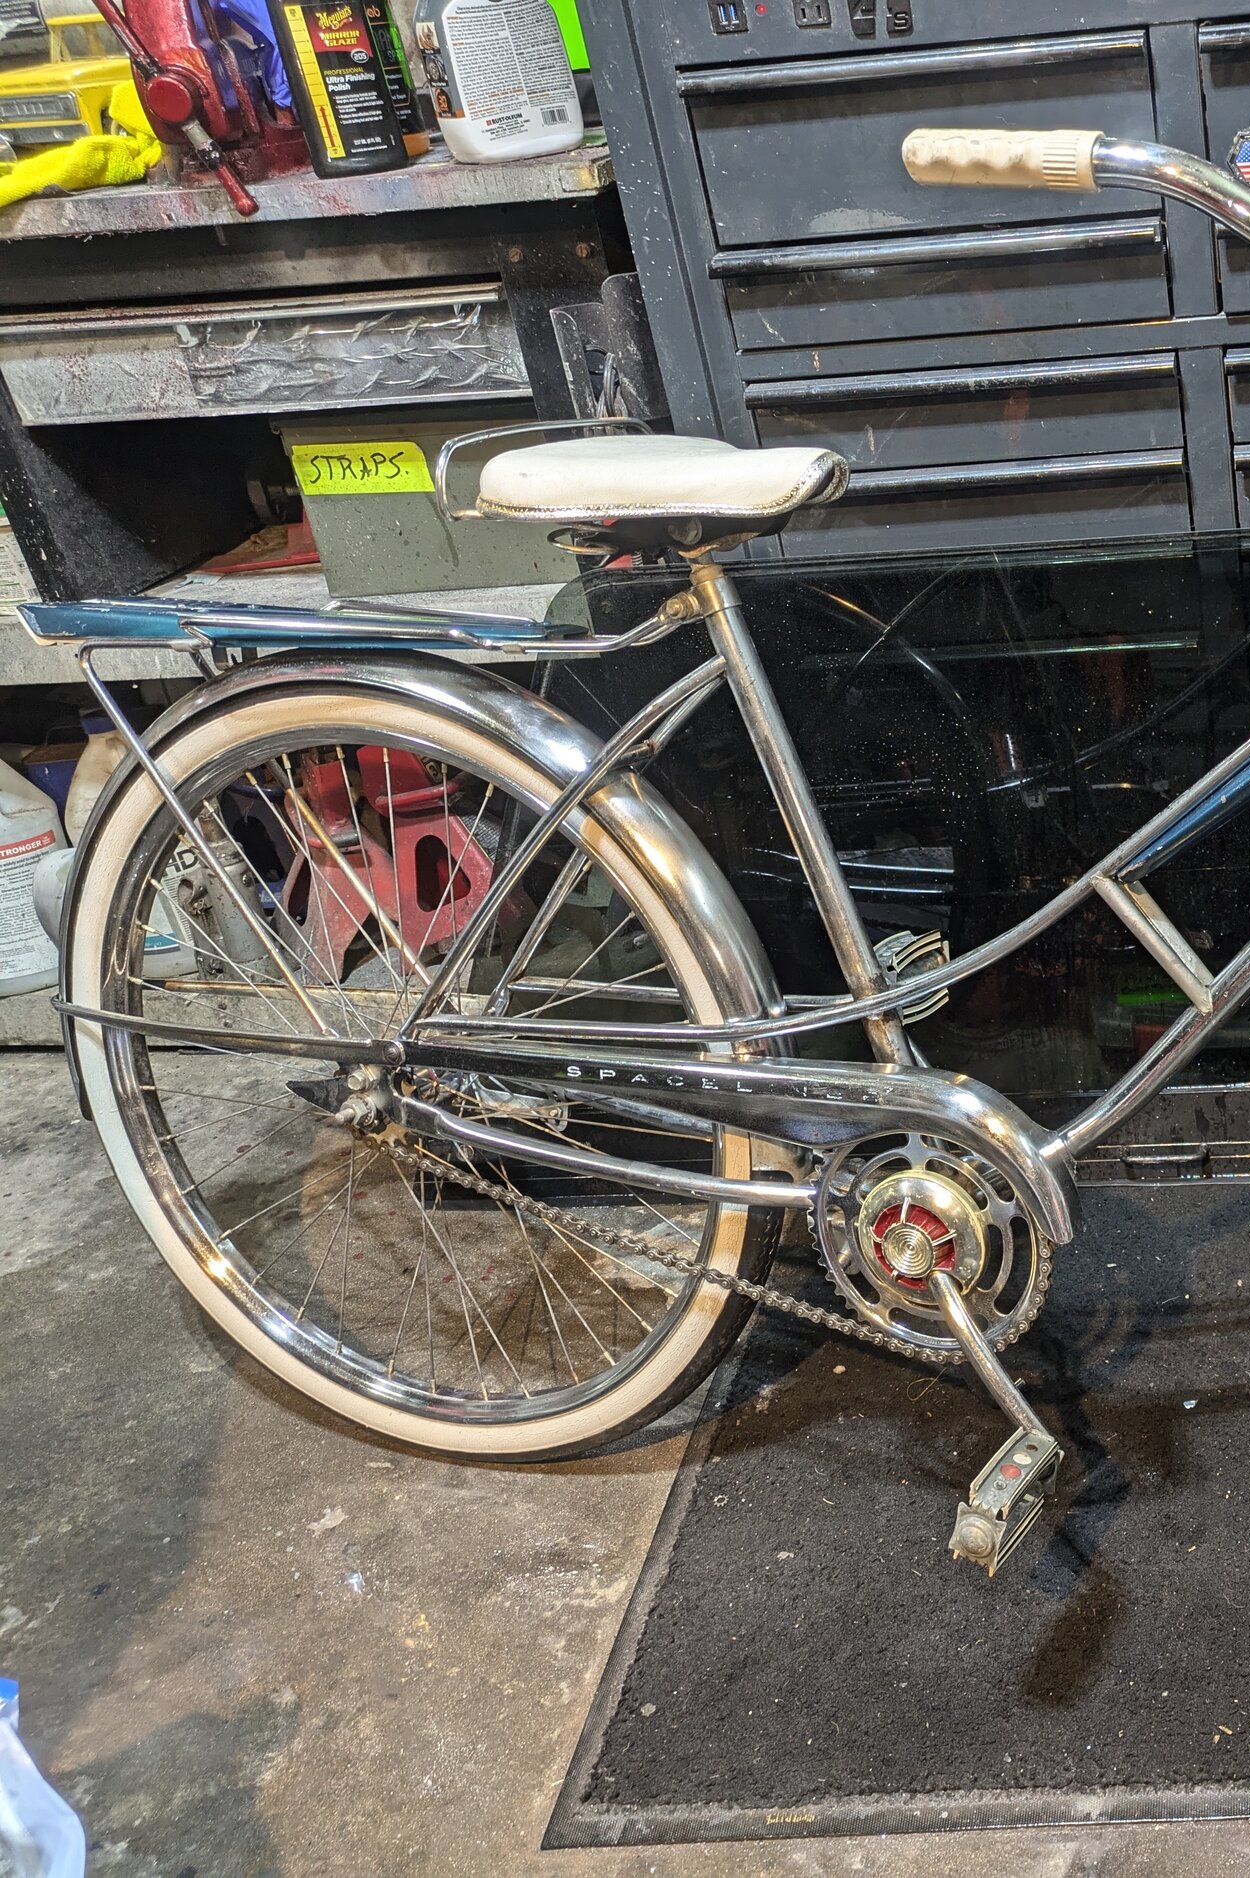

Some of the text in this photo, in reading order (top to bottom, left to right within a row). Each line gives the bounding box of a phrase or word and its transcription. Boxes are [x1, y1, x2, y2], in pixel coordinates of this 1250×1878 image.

[319, 31, 360, 41] MIRROR
[324, 38, 358, 47] GLAZE
[324, 67, 365, 76] PROFESSIONAL
[326, 76, 345, 84] Ultra
[345, 72, 376, 82] Finishing
[328, 83, 351, 92] Polish
[567, 1066, 878, 1103] SPACELNE
